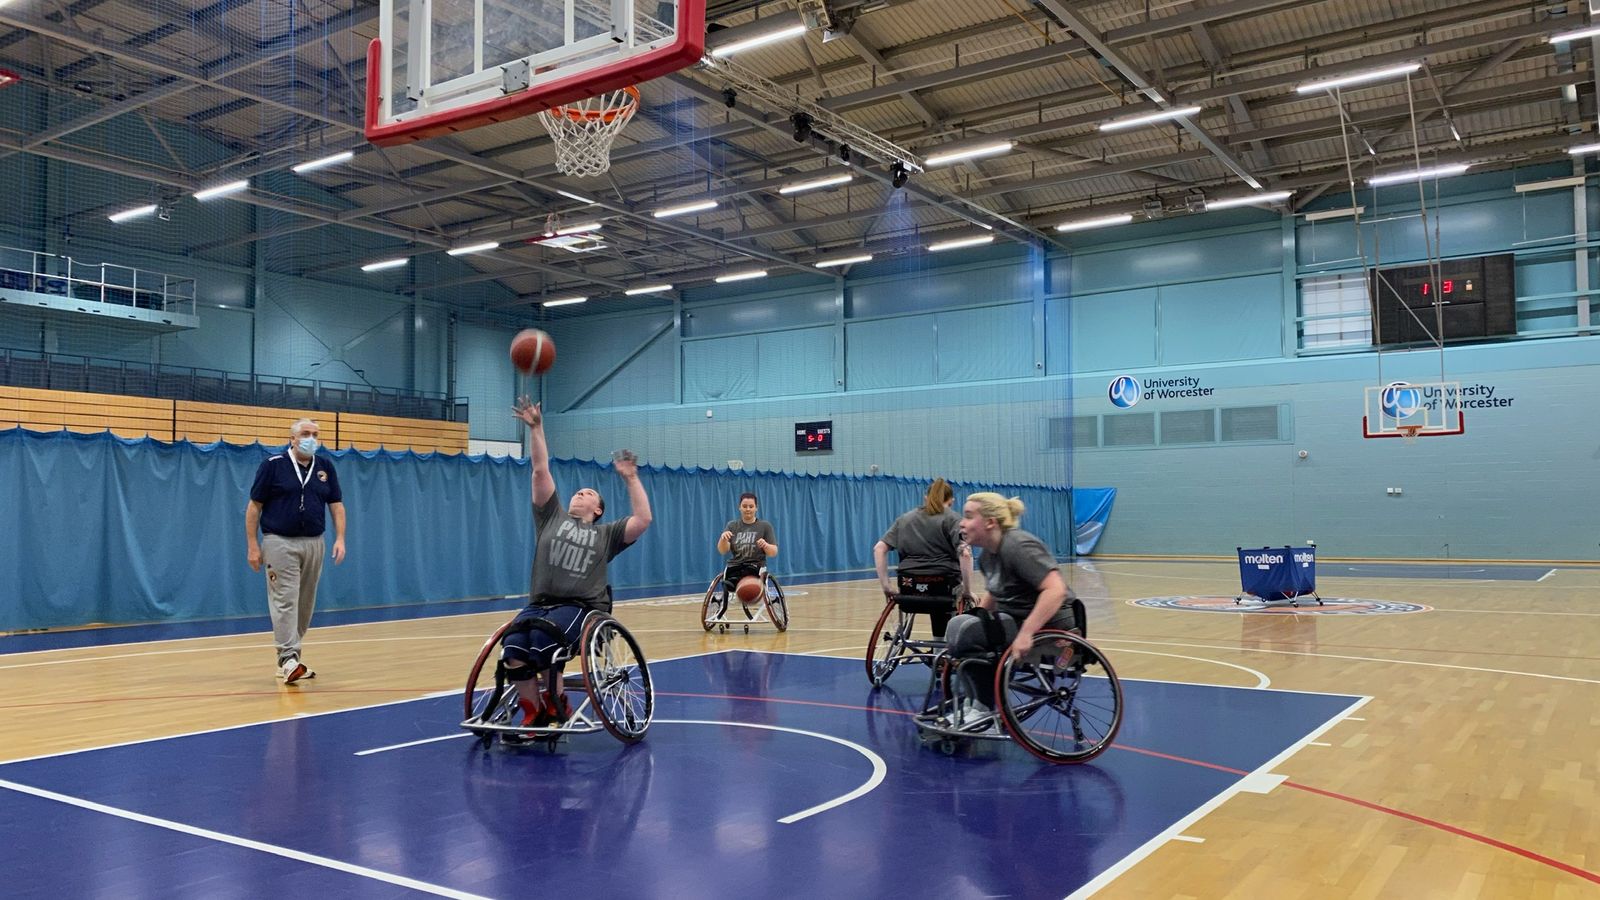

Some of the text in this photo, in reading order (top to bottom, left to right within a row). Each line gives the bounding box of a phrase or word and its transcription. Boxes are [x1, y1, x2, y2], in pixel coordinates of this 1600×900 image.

[1143, 376, 1200, 388] University
[1143, 387, 1215, 400] of Worcester
[1423, 384, 1495, 398] Unversity
[1423, 399, 1438, 411] of
[556, 520, 598, 547] PART
[735, 531, 757, 544] PART
[549, 539, 596, 573] WOLF
[1244, 553, 1284, 564] molten
[1294, 552, 1314, 562] molten
